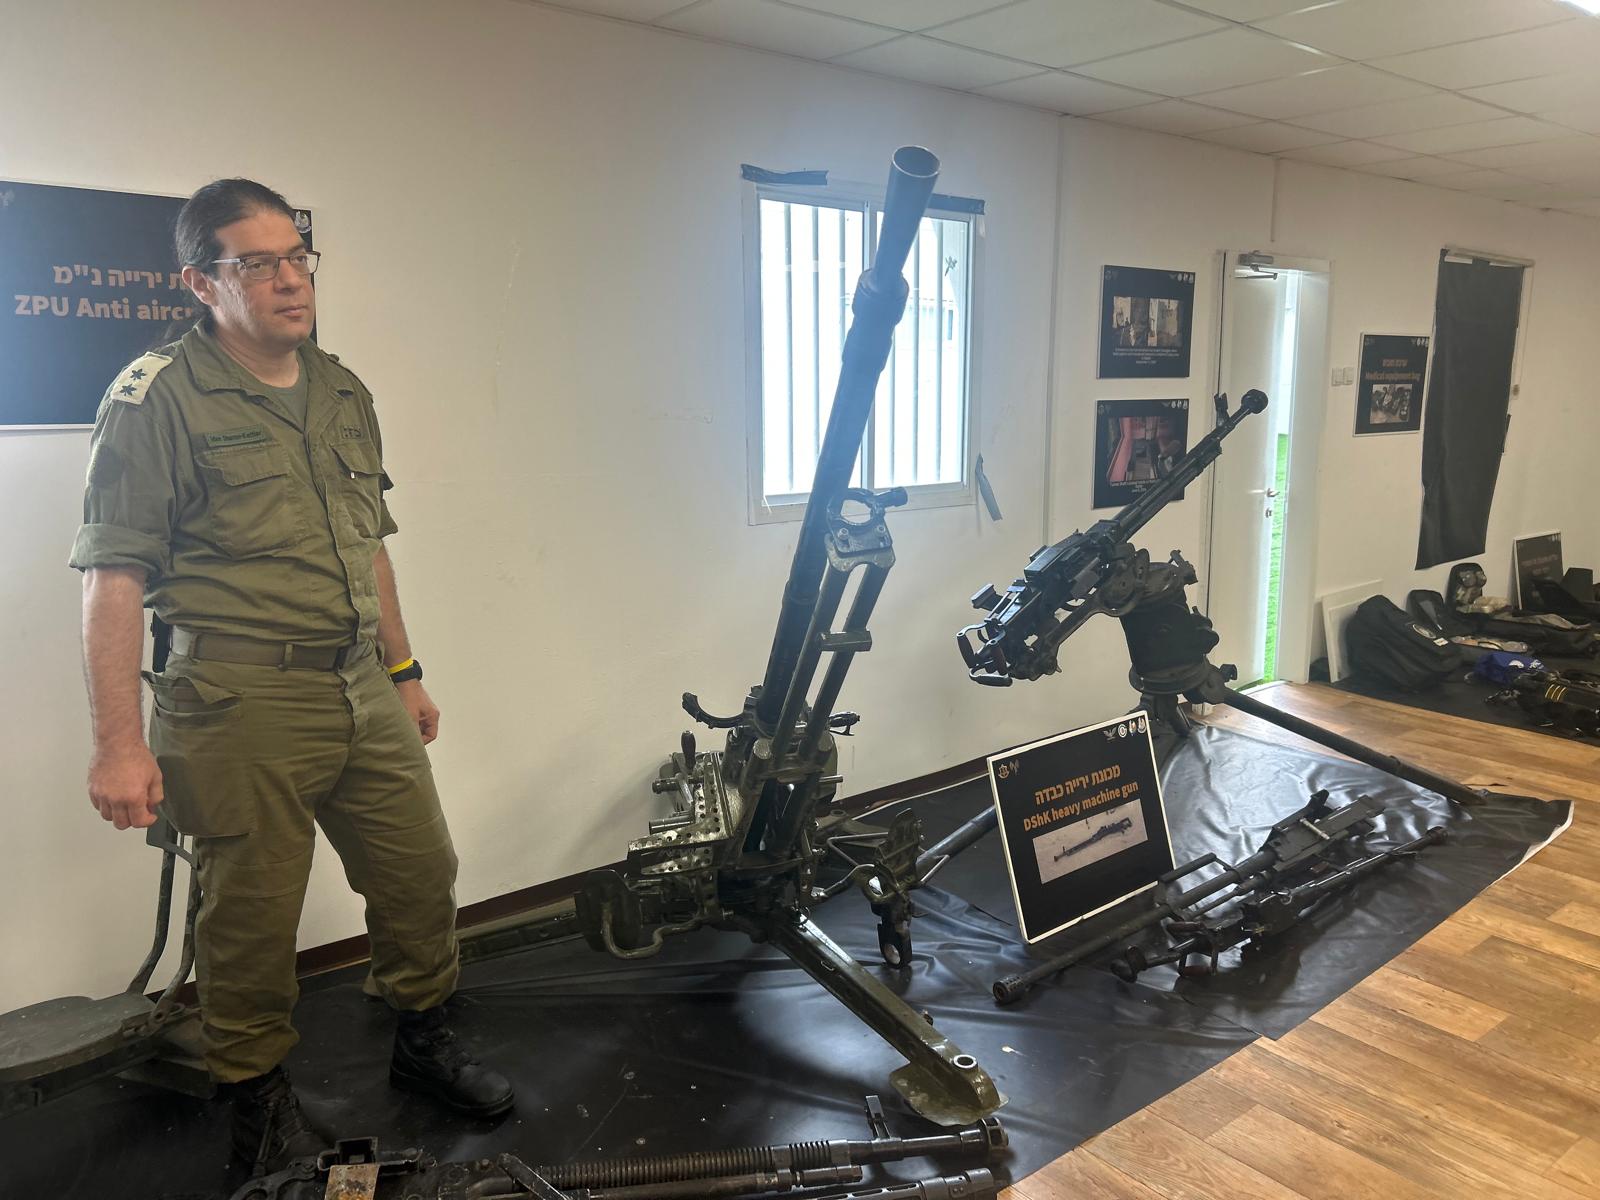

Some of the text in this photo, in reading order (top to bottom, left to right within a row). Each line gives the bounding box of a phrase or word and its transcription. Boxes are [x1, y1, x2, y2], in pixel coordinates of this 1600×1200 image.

[108, 269, 163, 288] ירייה
[14, 294, 69, 316] ZPU
[76, 297, 130, 319] Anti
[1035, 764, 1121, 806] מכונת ירייה כבדה
[1023, 781, 1139, 832] DShK heavy machine gun
